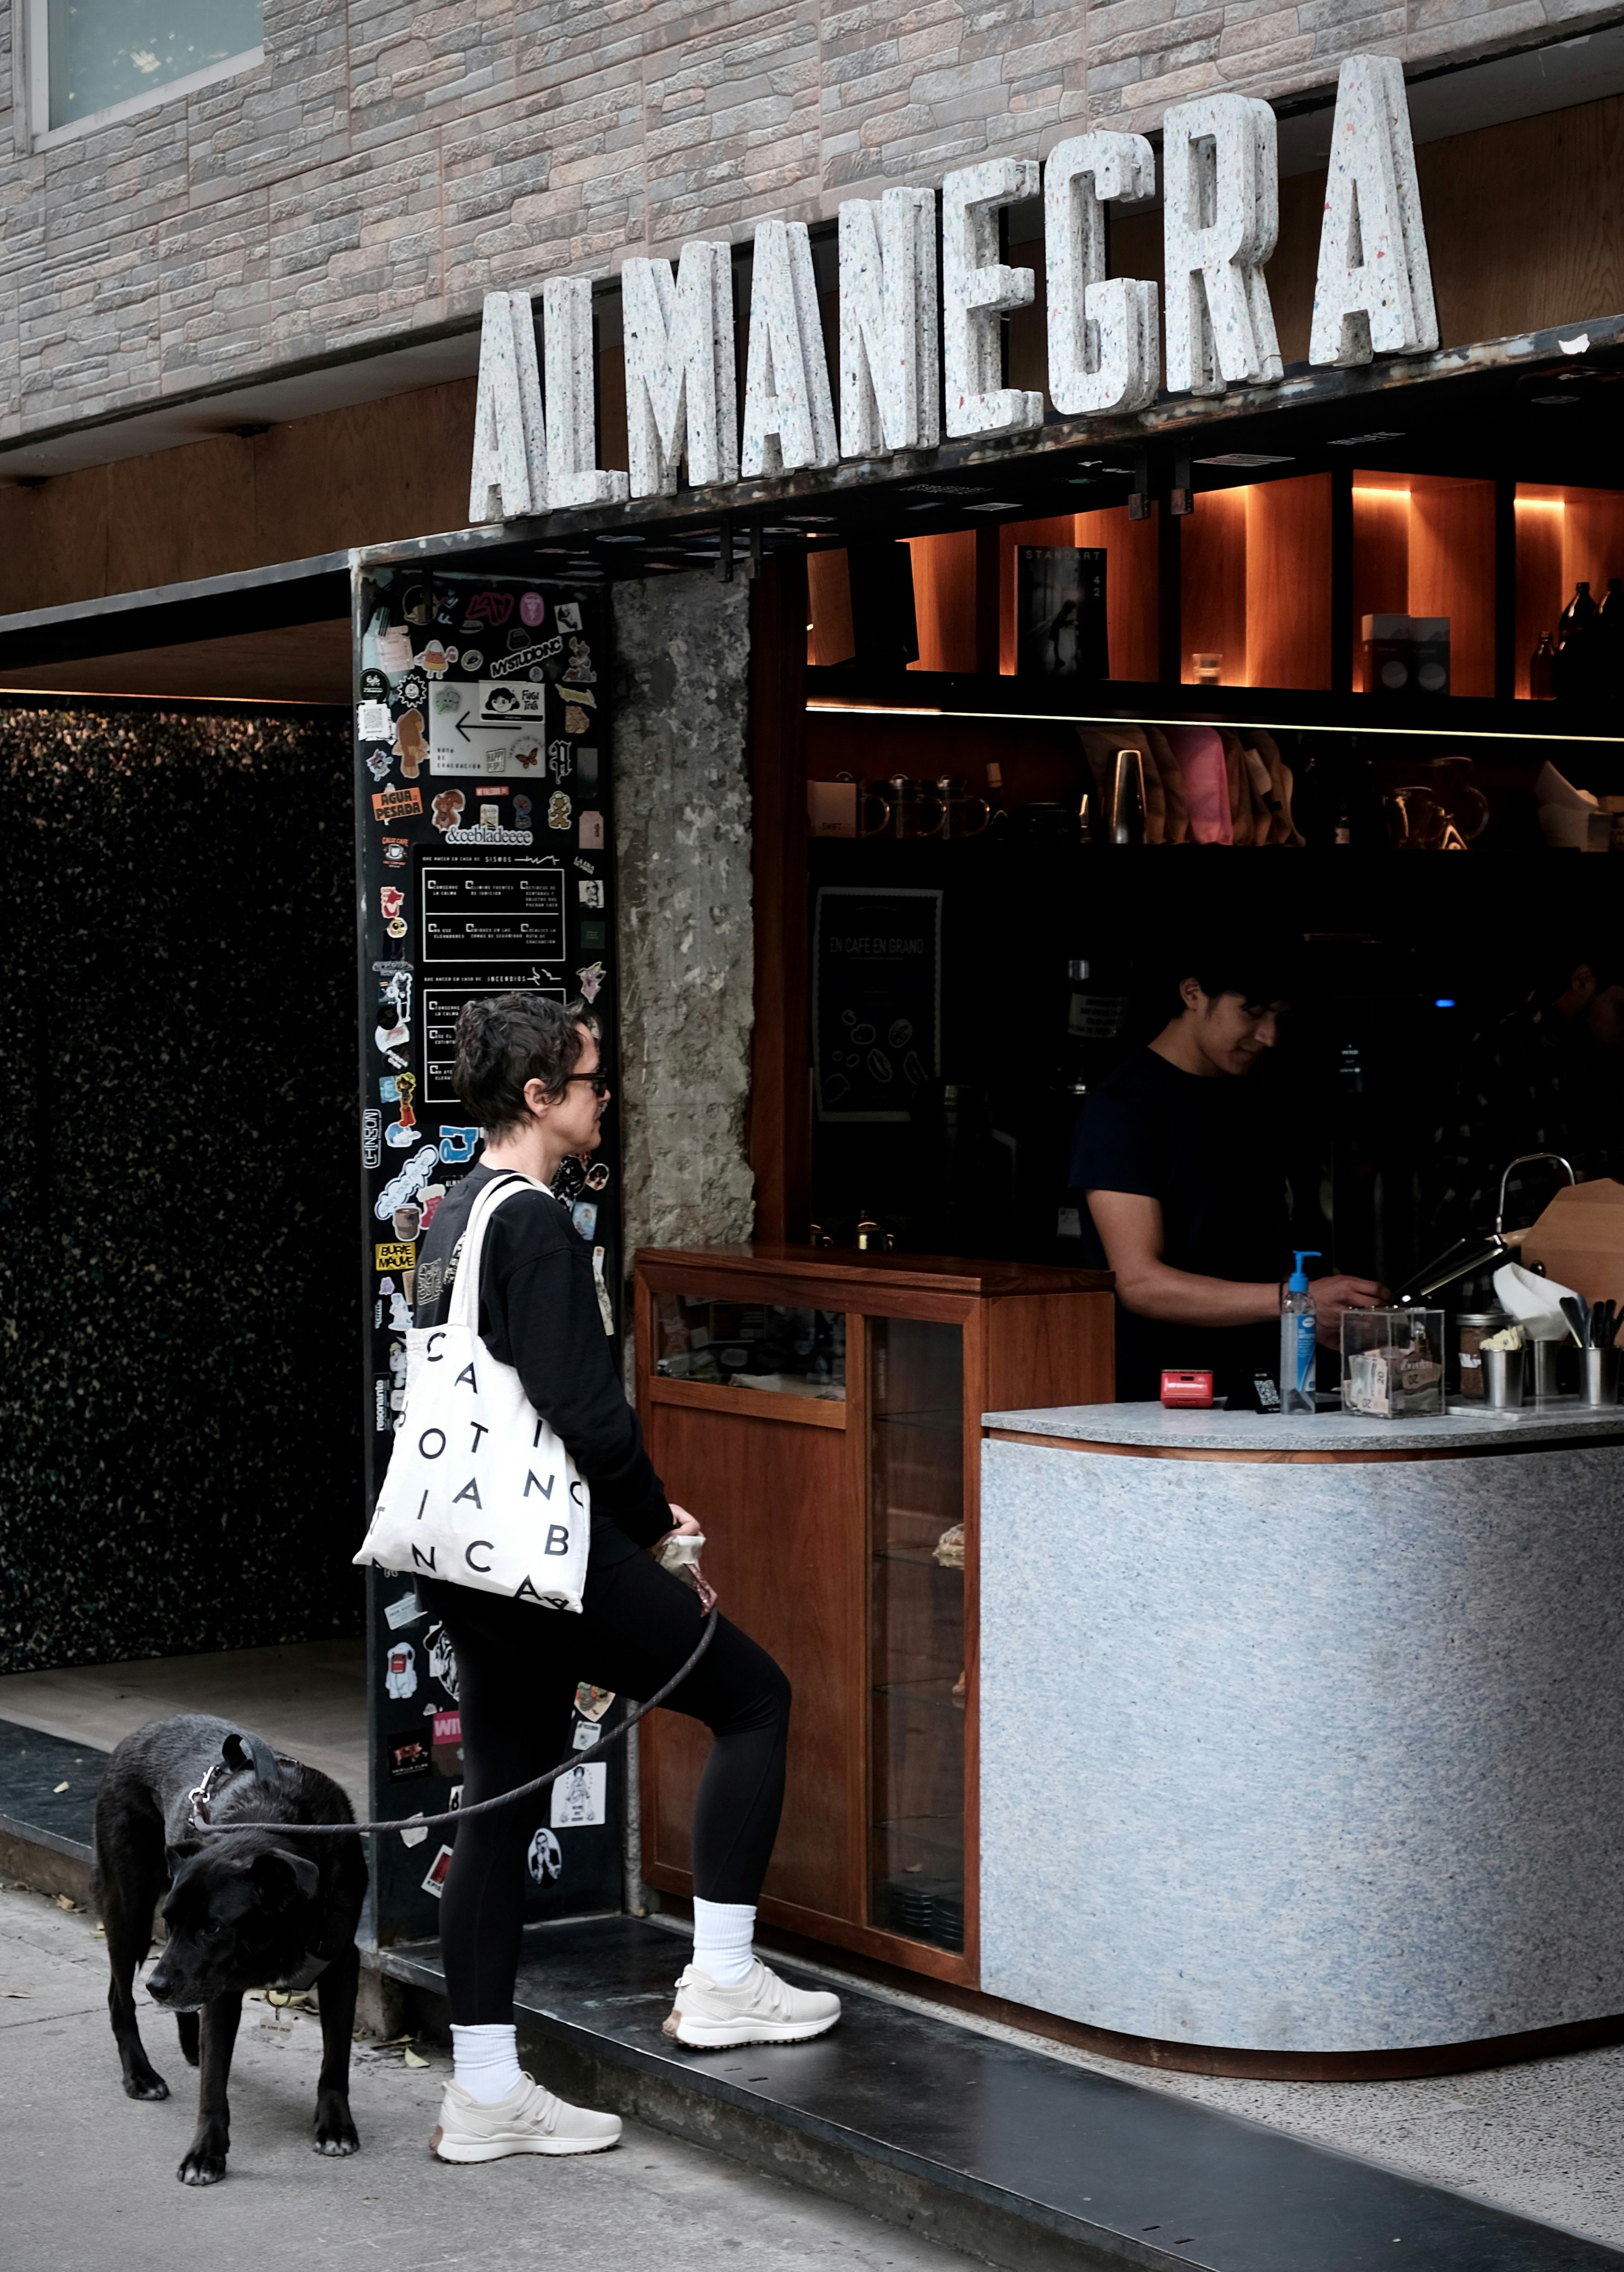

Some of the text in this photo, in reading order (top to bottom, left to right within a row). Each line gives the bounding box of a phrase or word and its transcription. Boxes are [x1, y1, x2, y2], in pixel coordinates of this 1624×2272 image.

[1025, 549, 1100, 560] STANDART
[381, 791, 411, 806] AGUA
[376, 802, 419, 819] PESADA
[873, 938, 886, 953] EN
[889, 938, 924, 954] GRANO
[379, 1255, 414, 1268] MAUVE
[454, 1362, 478, 1394] A
[419, 1428, 446, 1459] O
[470, 1421, 489, 1454] T
[452, 1477, 483, 1510] A
[524, 1469, 555, 1500] N
[466, 1540, 495, 1572] C
[544, 1524, 569, 1556] B
